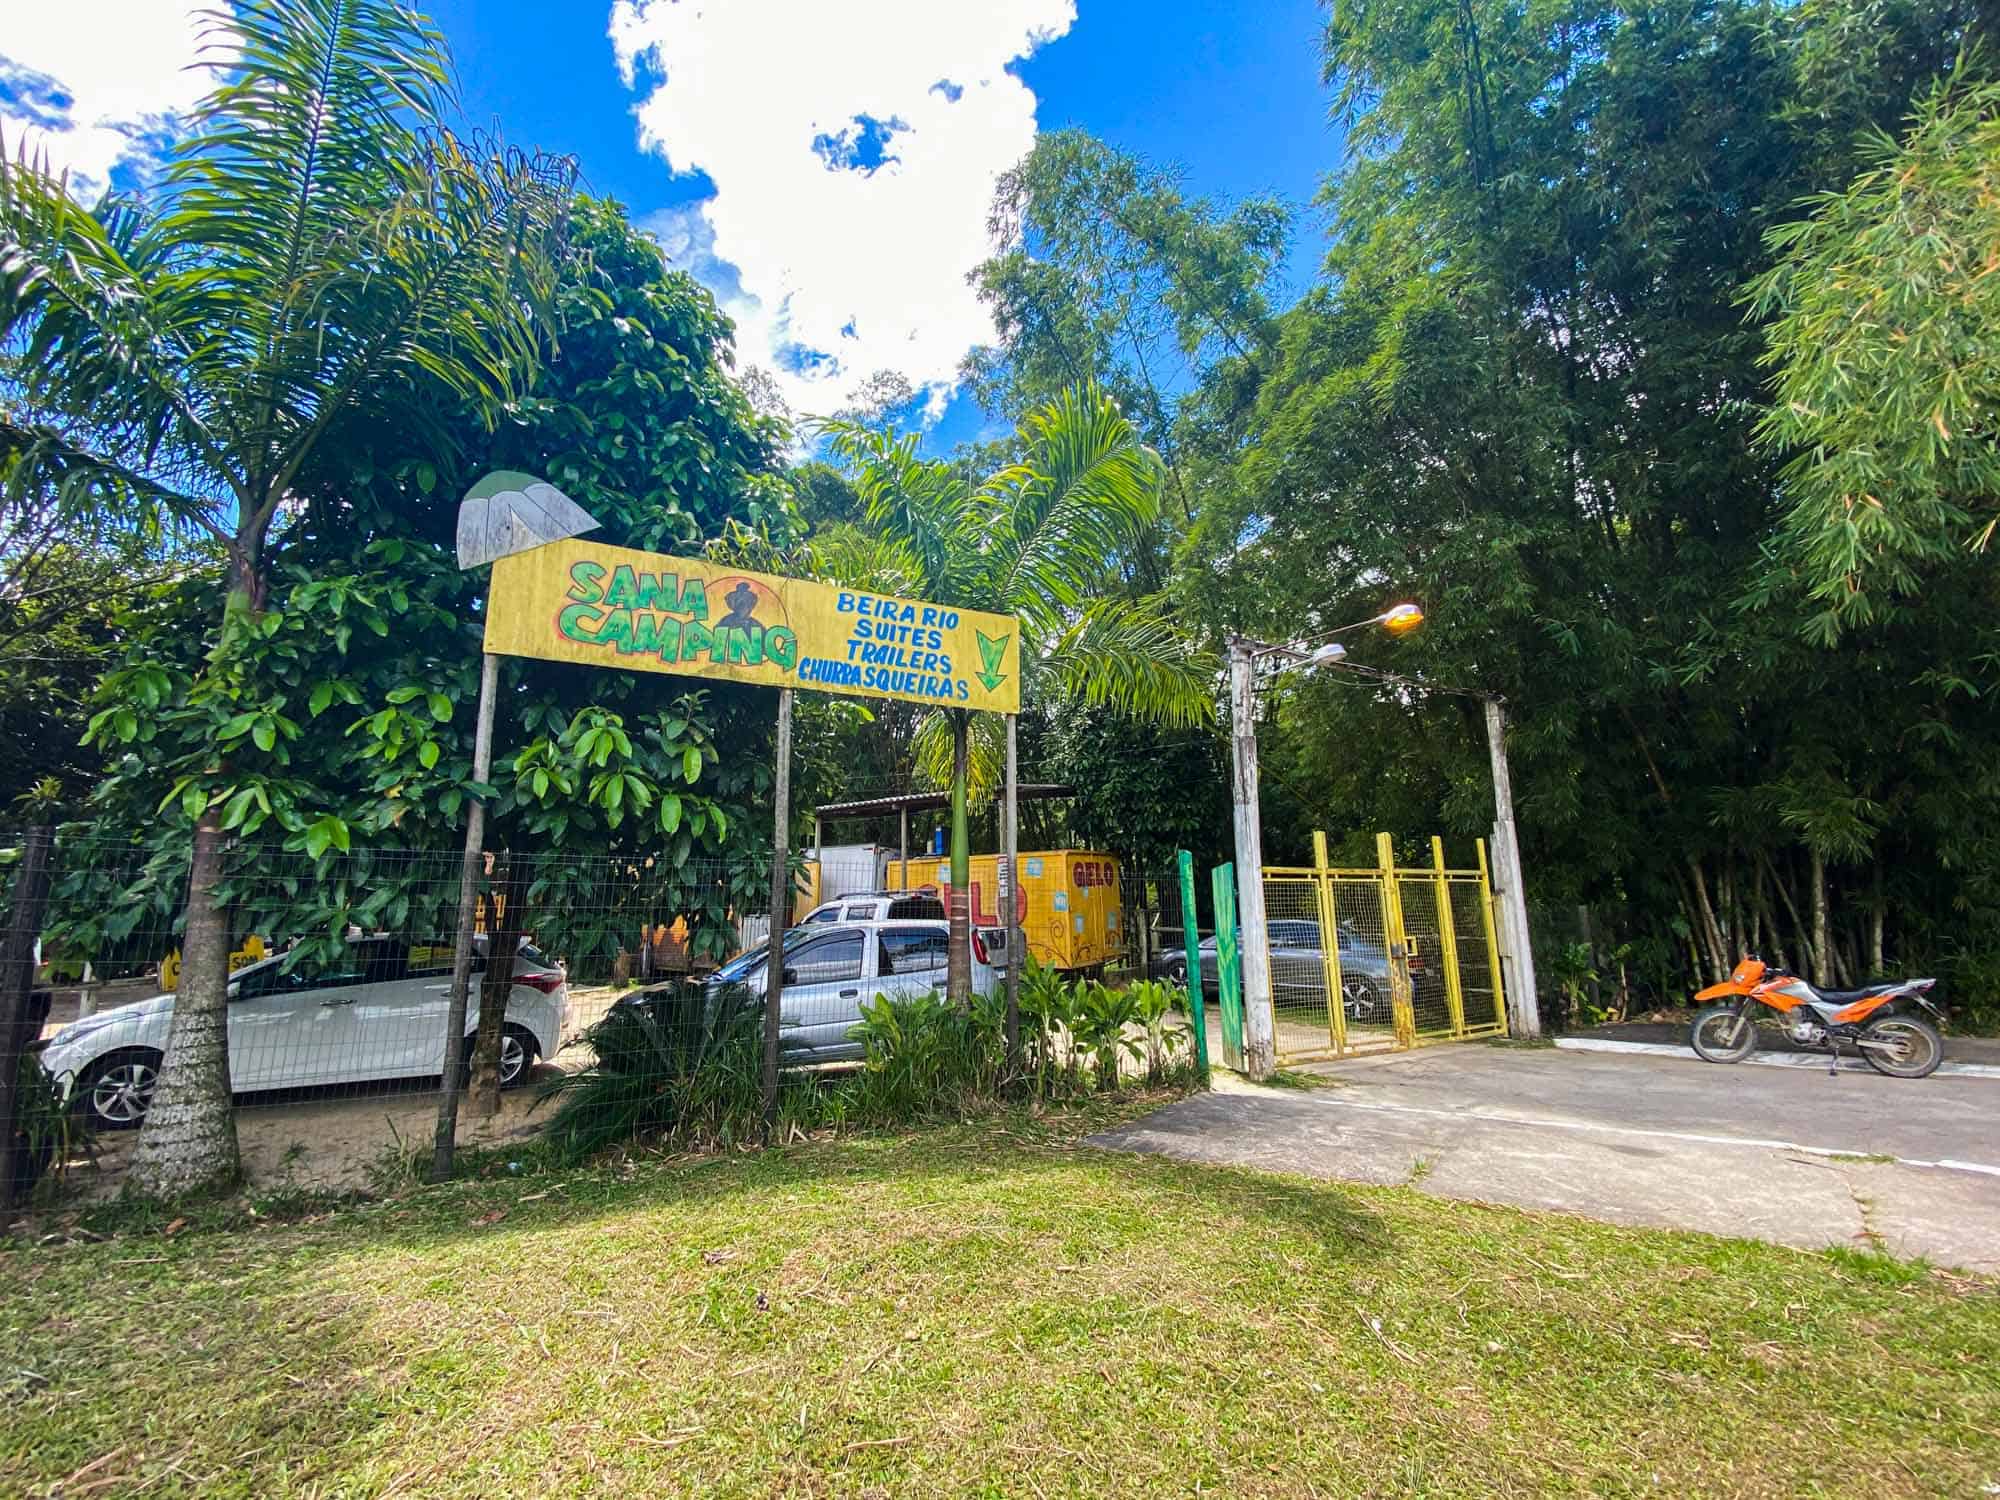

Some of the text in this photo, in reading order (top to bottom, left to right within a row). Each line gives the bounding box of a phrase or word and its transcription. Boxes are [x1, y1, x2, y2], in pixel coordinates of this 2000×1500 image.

[566, 561, 708, 621] SANA
[837, 592, 959, 630] BEIRA RIO
[559, 603, 798, 672] CAMPING
[854, 618, 943, 650] SUITES
[847, 639, 953, 674] TRAILERS
[798, 656, 969, 700] CHURRASQUEIRAS
[1072, 861, 1114, 888] GELO
